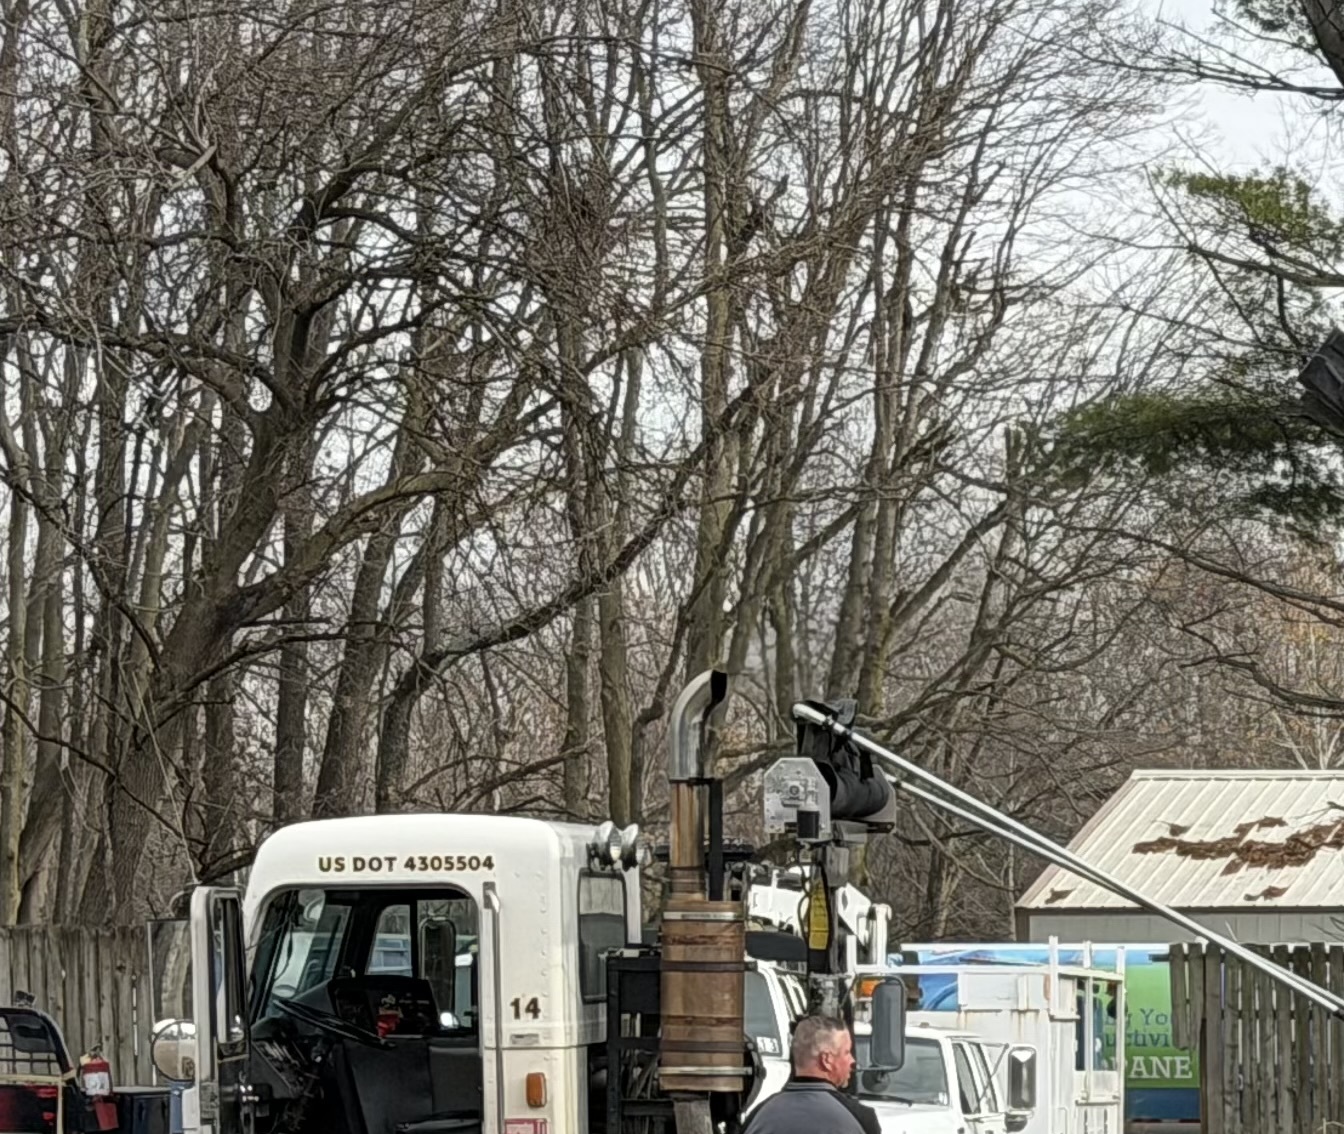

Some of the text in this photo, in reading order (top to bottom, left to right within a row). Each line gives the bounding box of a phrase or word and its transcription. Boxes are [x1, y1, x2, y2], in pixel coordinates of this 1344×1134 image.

[318, 855, 495, 873] US DOT 4305504
[510, 996, 541, 1020] 14
